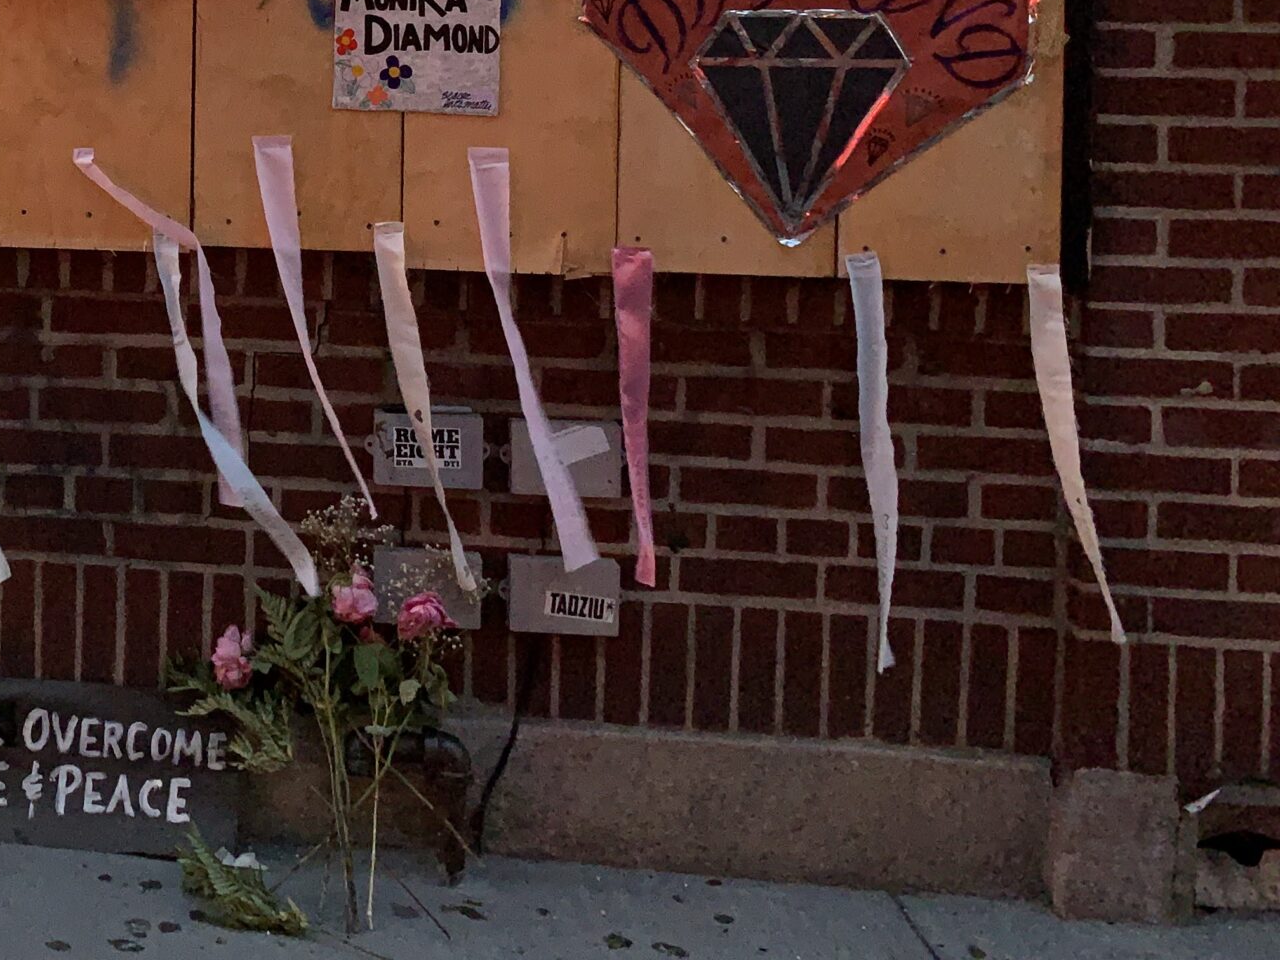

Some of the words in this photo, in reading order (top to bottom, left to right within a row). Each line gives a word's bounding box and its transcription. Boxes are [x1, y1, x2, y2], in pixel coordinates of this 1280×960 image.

[364, 14, 501, 56] DIAMOND
[22, 706, 230, 771] OVERCOME
[49, 763, 194, 824] PEACE
